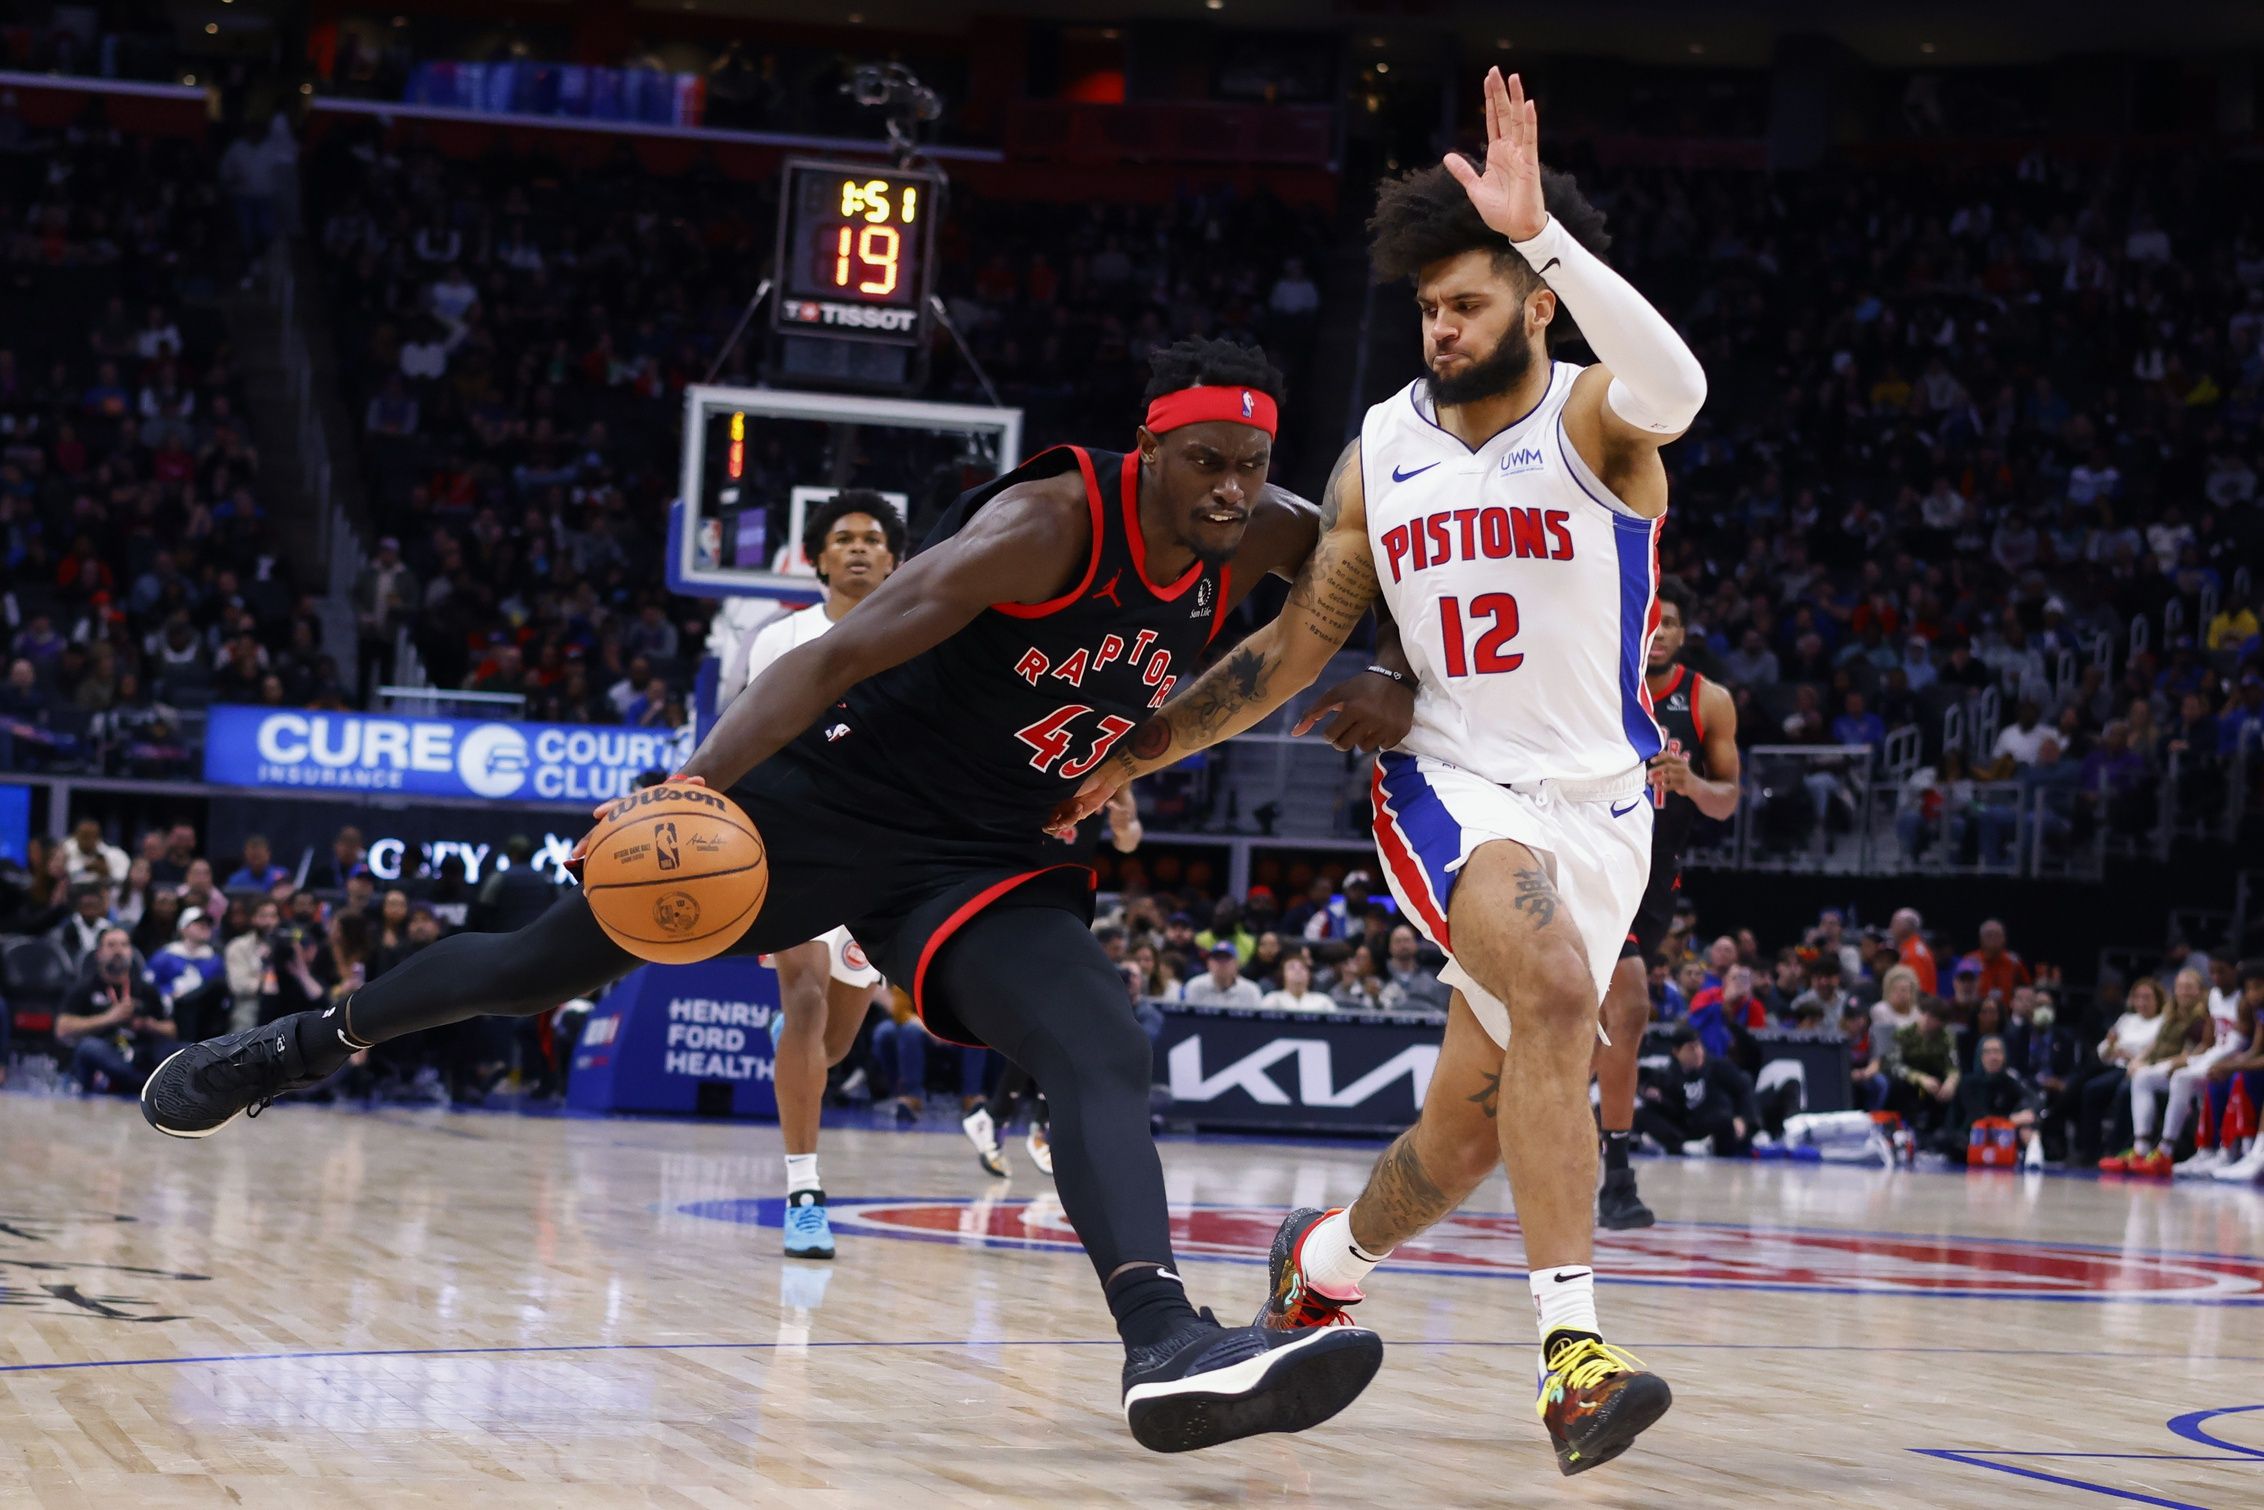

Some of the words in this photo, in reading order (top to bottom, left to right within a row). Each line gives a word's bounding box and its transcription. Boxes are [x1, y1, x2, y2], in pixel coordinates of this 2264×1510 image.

[841, 180, 917, 223] 1:51
[836, 224, 900, 295] 19
[820, 303, 918, 332] TISSOT
[1501, 448, 1543, 470] UWM
[1381, 507, 1574, 584] PISTONS
[1439, 592, 1524, 678] 12
[257, 713, 454, 772] CURE
[257, 763, 404, 789] INSURANCE
[608, 786, 727, 822] Wilson
[668, 999, 771, 1028] HENRY
[667, 1024, 745, 1052] FORD
[665, 1051, 775, 1081] HEALTH
